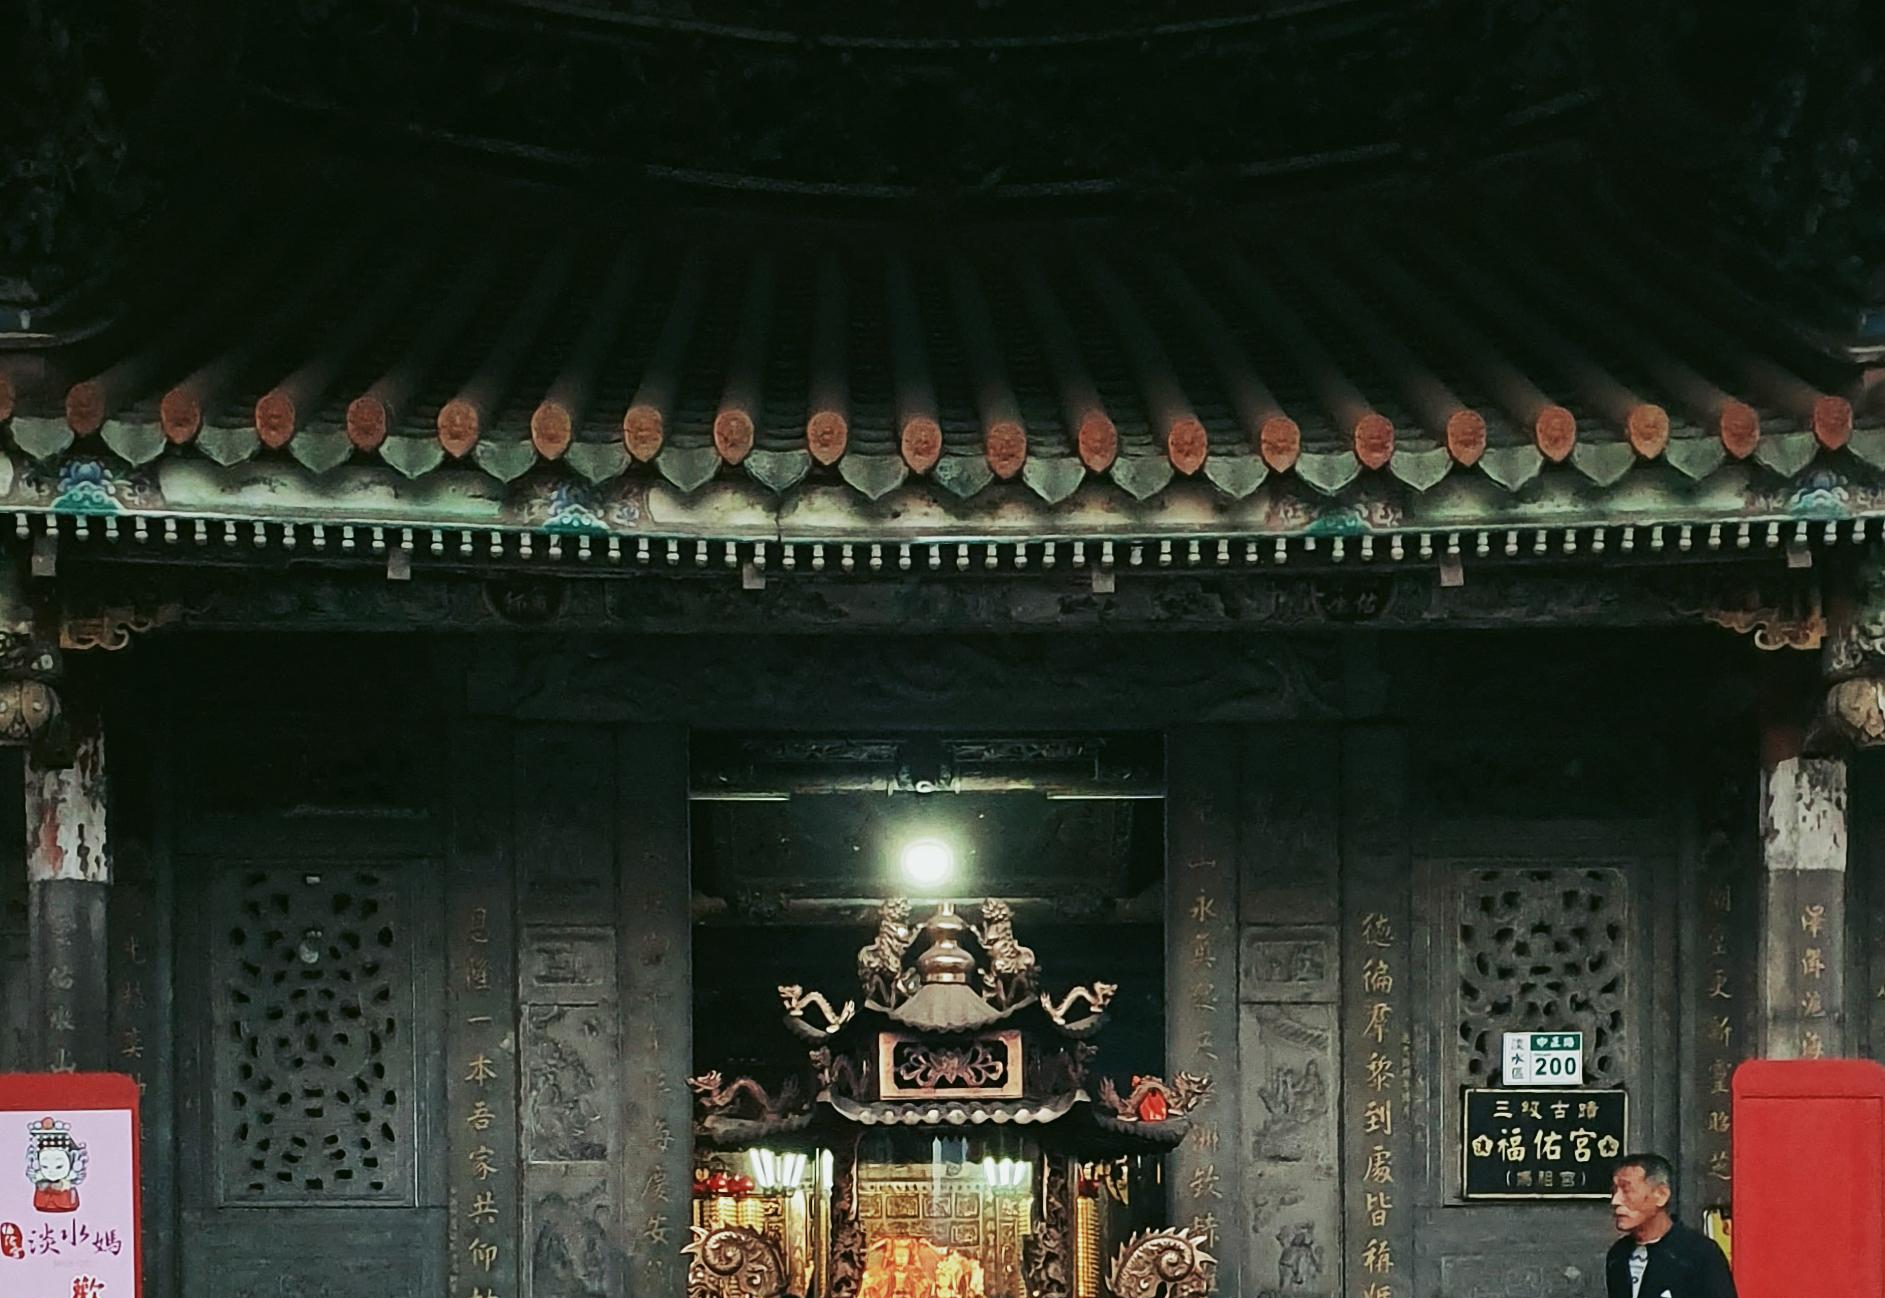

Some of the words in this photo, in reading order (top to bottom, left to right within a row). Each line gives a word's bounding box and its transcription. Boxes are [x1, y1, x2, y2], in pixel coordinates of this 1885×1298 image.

[1534, 1057, 1577, 1076] 200
[1497, 1127, 1598, 1163] 福佑宮
[27, 1217, 122, 1256] 淡水媽
